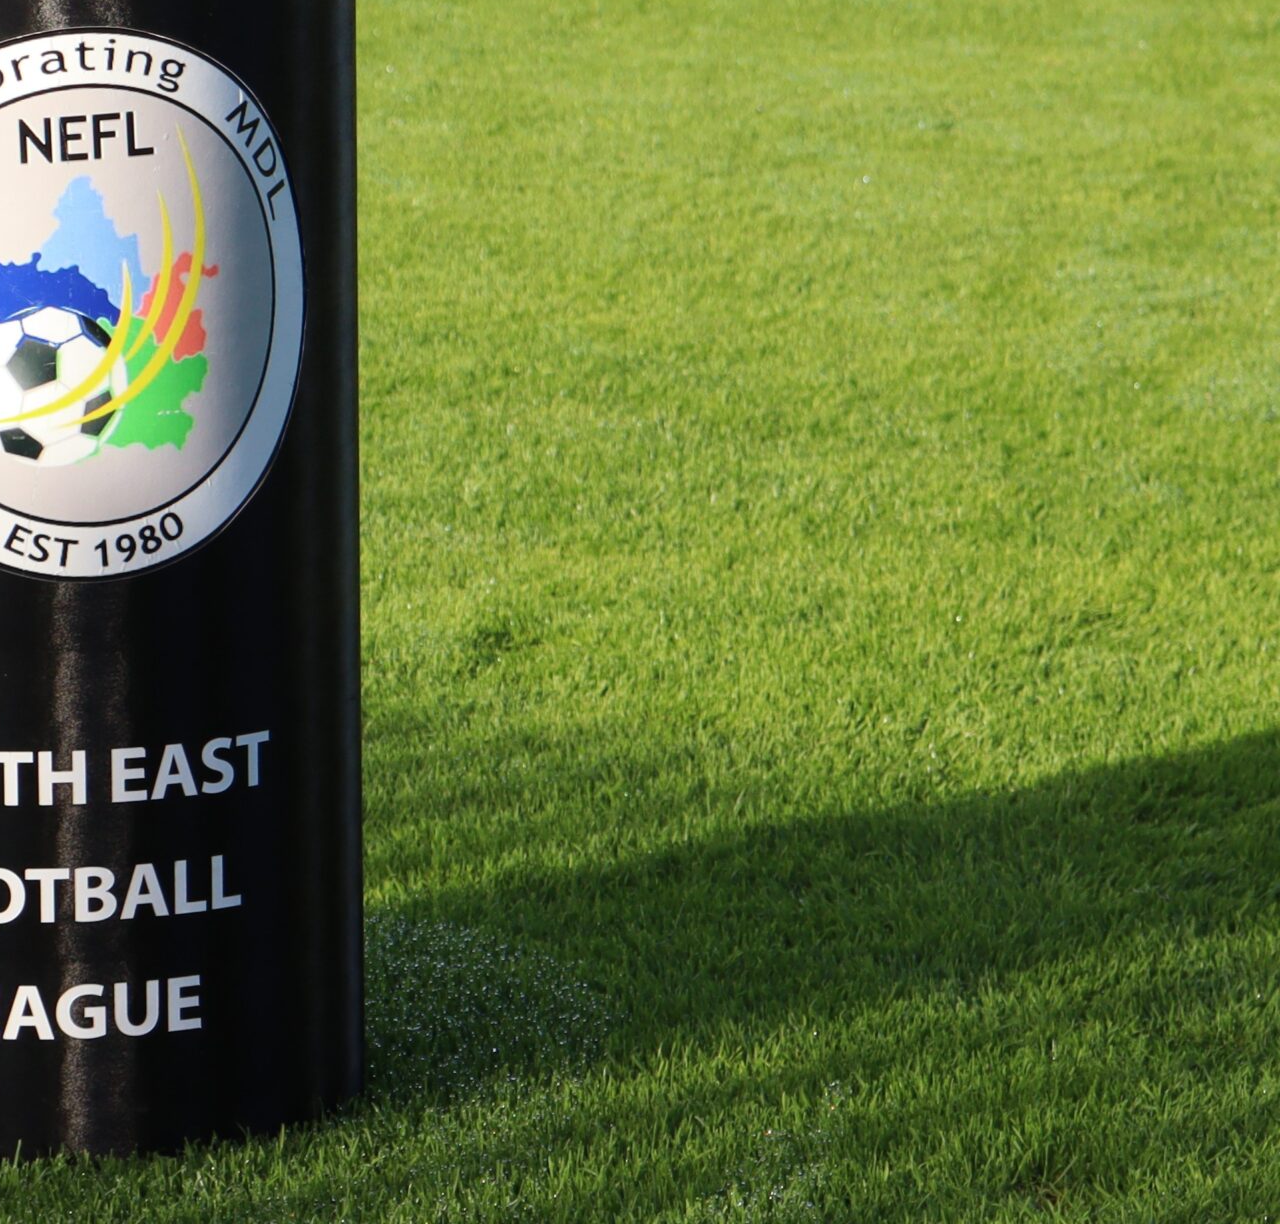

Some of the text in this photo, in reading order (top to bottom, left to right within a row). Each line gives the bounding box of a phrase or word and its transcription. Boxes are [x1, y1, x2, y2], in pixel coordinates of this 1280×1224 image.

[19, 111, 154, 164] NEFL
[225, 97, 291, 222] MDL
[3, 512, 184, 567] EST 1980
[111, 730, 269, 803] EAST
